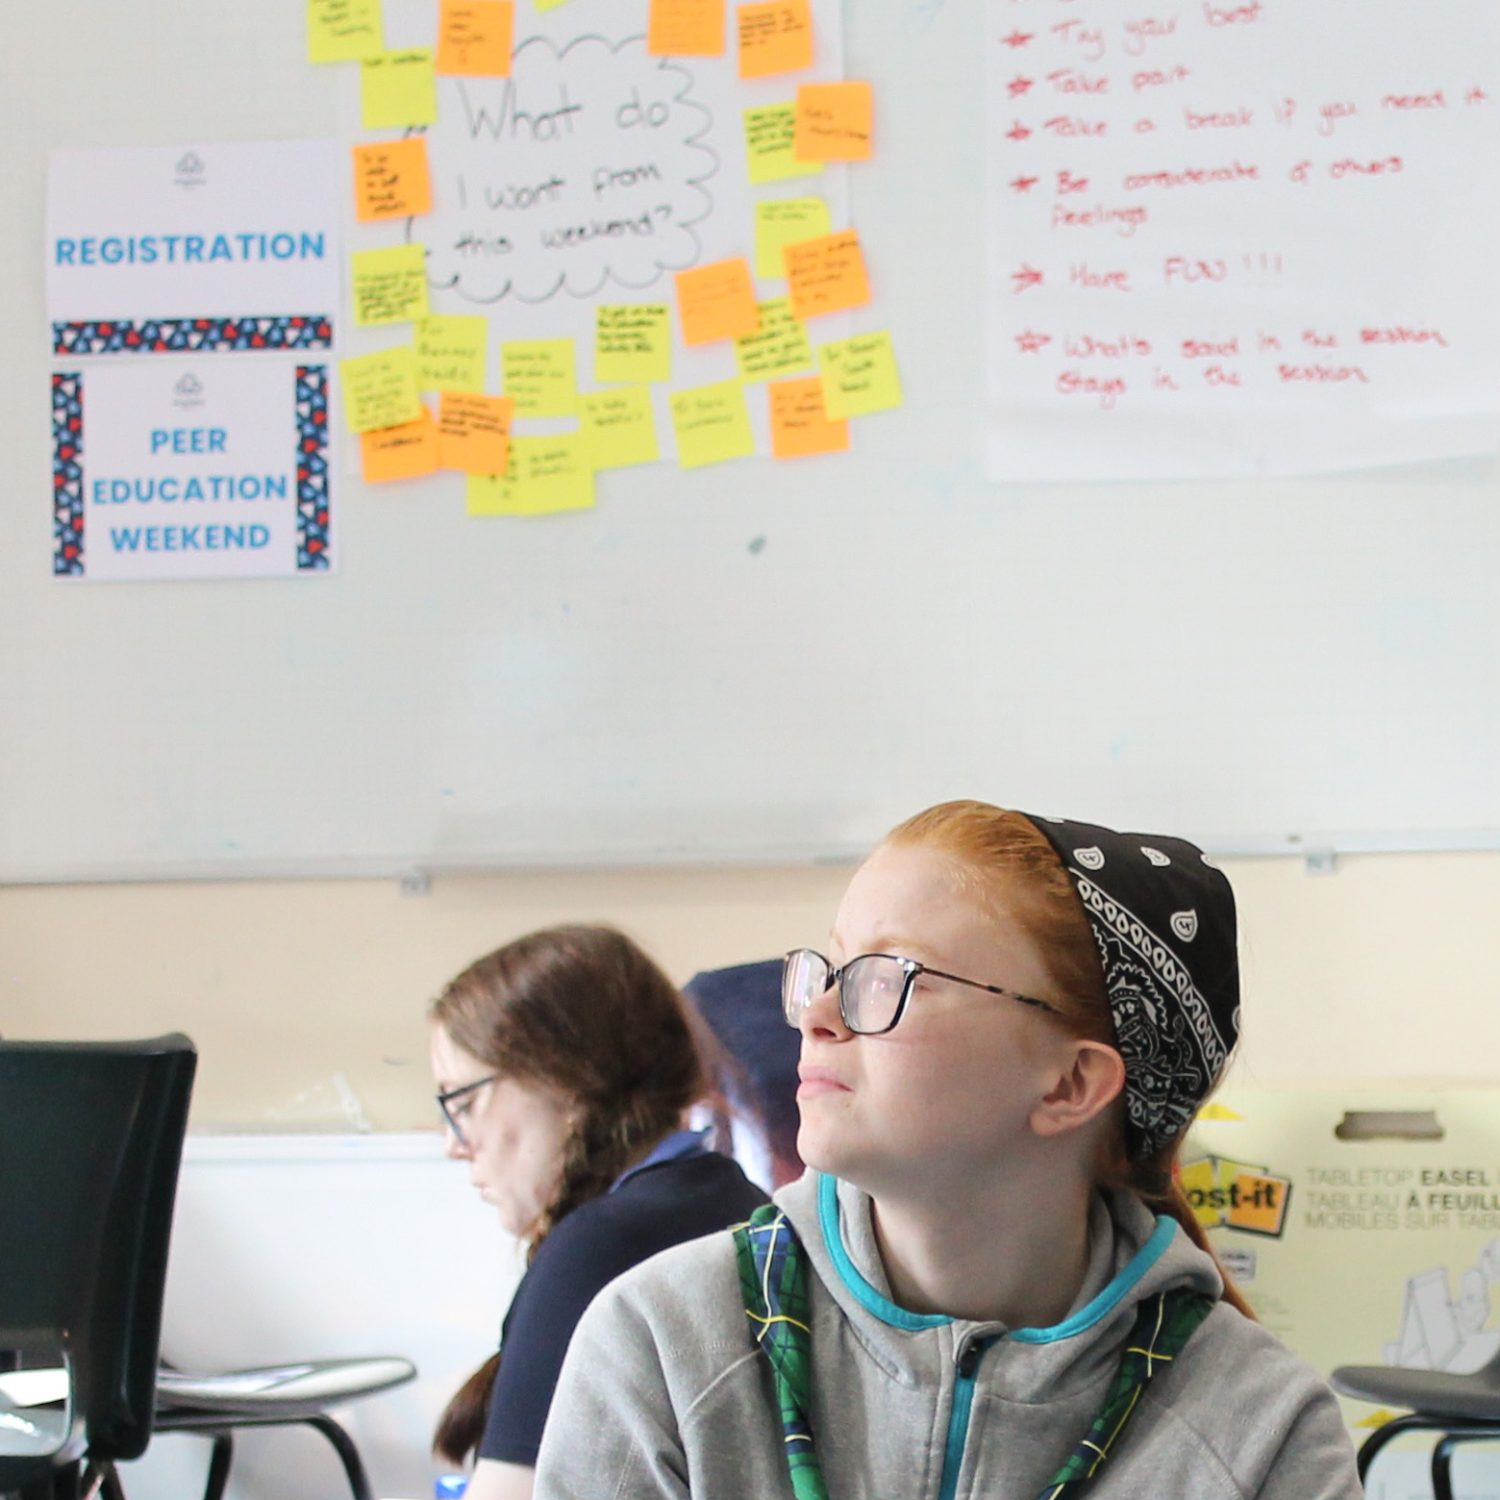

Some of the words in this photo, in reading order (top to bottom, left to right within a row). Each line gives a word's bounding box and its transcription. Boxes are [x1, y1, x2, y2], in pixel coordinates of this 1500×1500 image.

[456, 78, 583, 140] What
[615, 85, 670, 129] do
[1133, 117, 1155, 134] a
[1184, 105, 1253, 130] break
[456, 174, 467, 210] I
[484, 176, 565, 210] want
[55, 233, 325, 266] REGISTRATION
[150, 428, 228, 456] PEER
[92, 476, 287, 505] EDUCATION
[110, 524, 270, 553] WEEKEND
[1421, 1169, 1490, 1187] EASEL
[1186, 1180, 1277, 1209] ost-it
[1305, 1212, 1399, 1230] MOBILES
[1405, 1212, 1449, 1230] SUR
